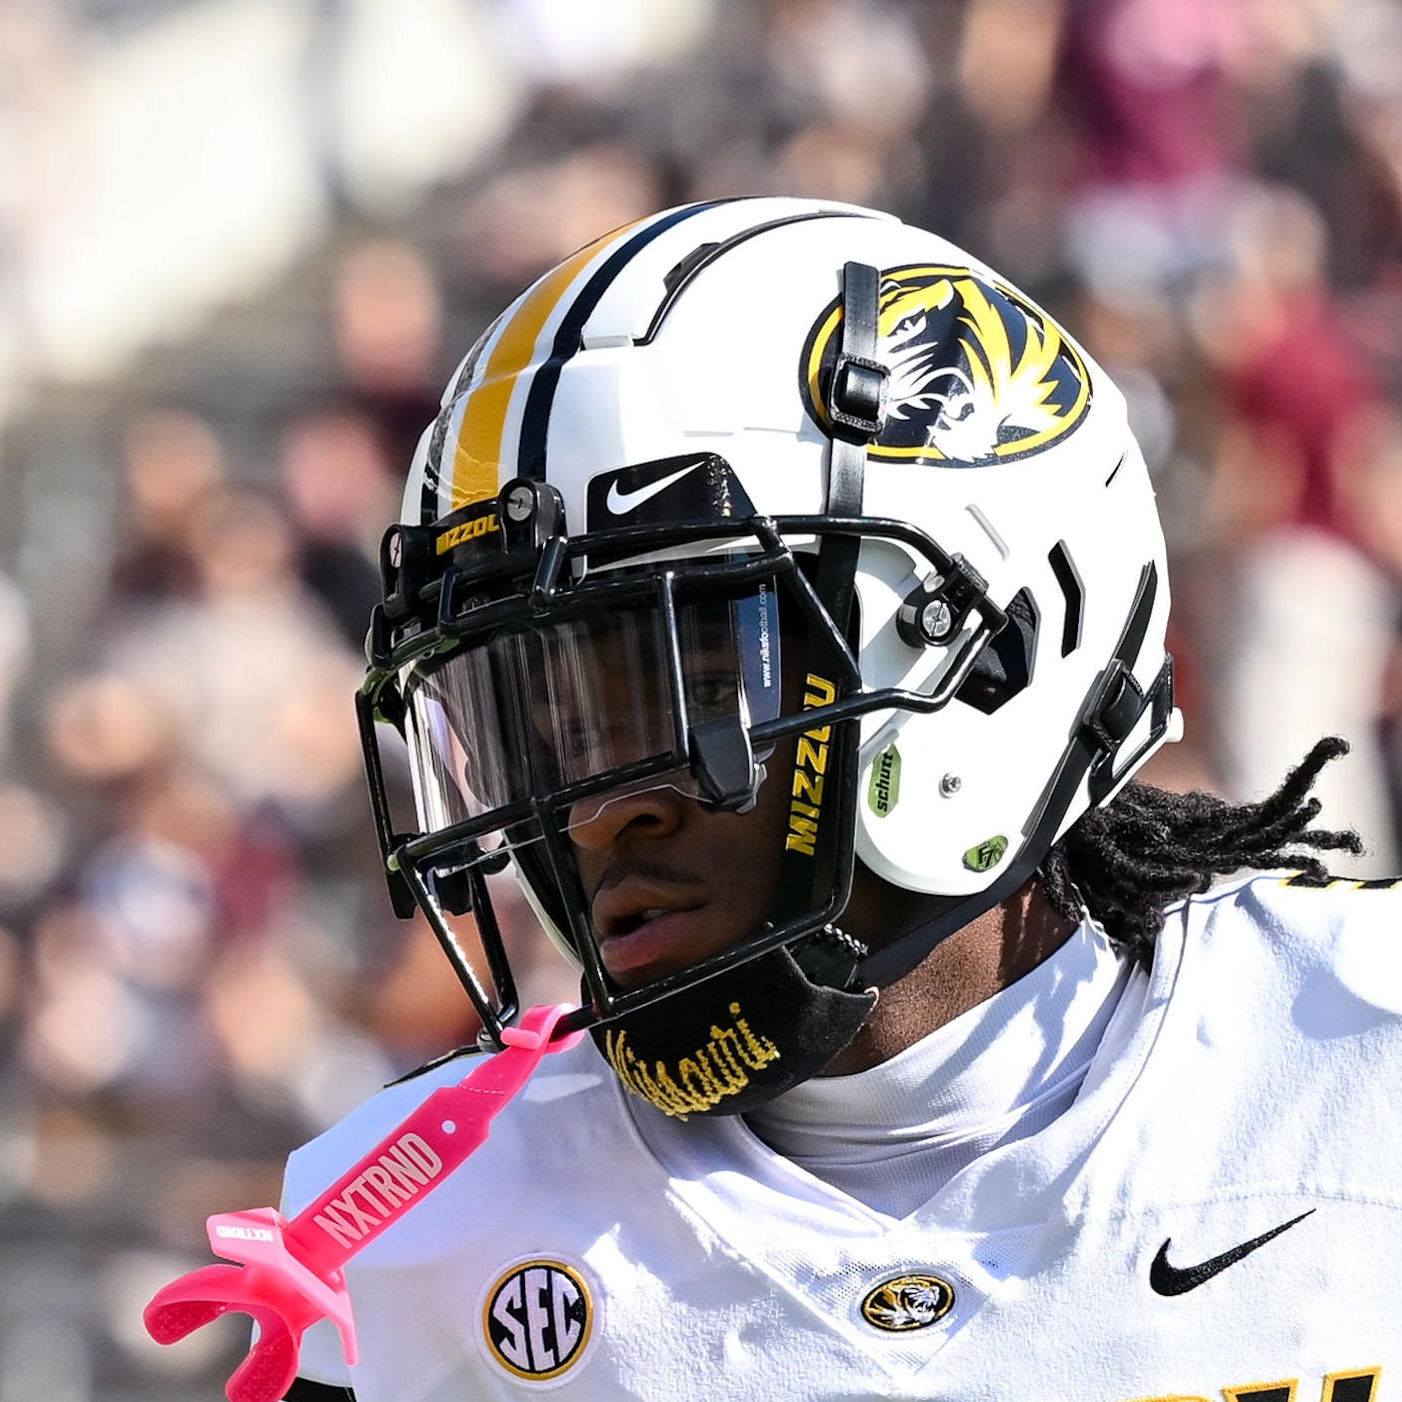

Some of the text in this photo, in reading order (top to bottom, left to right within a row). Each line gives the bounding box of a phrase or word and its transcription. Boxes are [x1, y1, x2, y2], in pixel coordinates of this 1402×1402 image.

[873, 751, 895, 812] schutt
[312, 1132, 443, 1249] NXTRND
[492, 1267, 582, 1371] SEC
